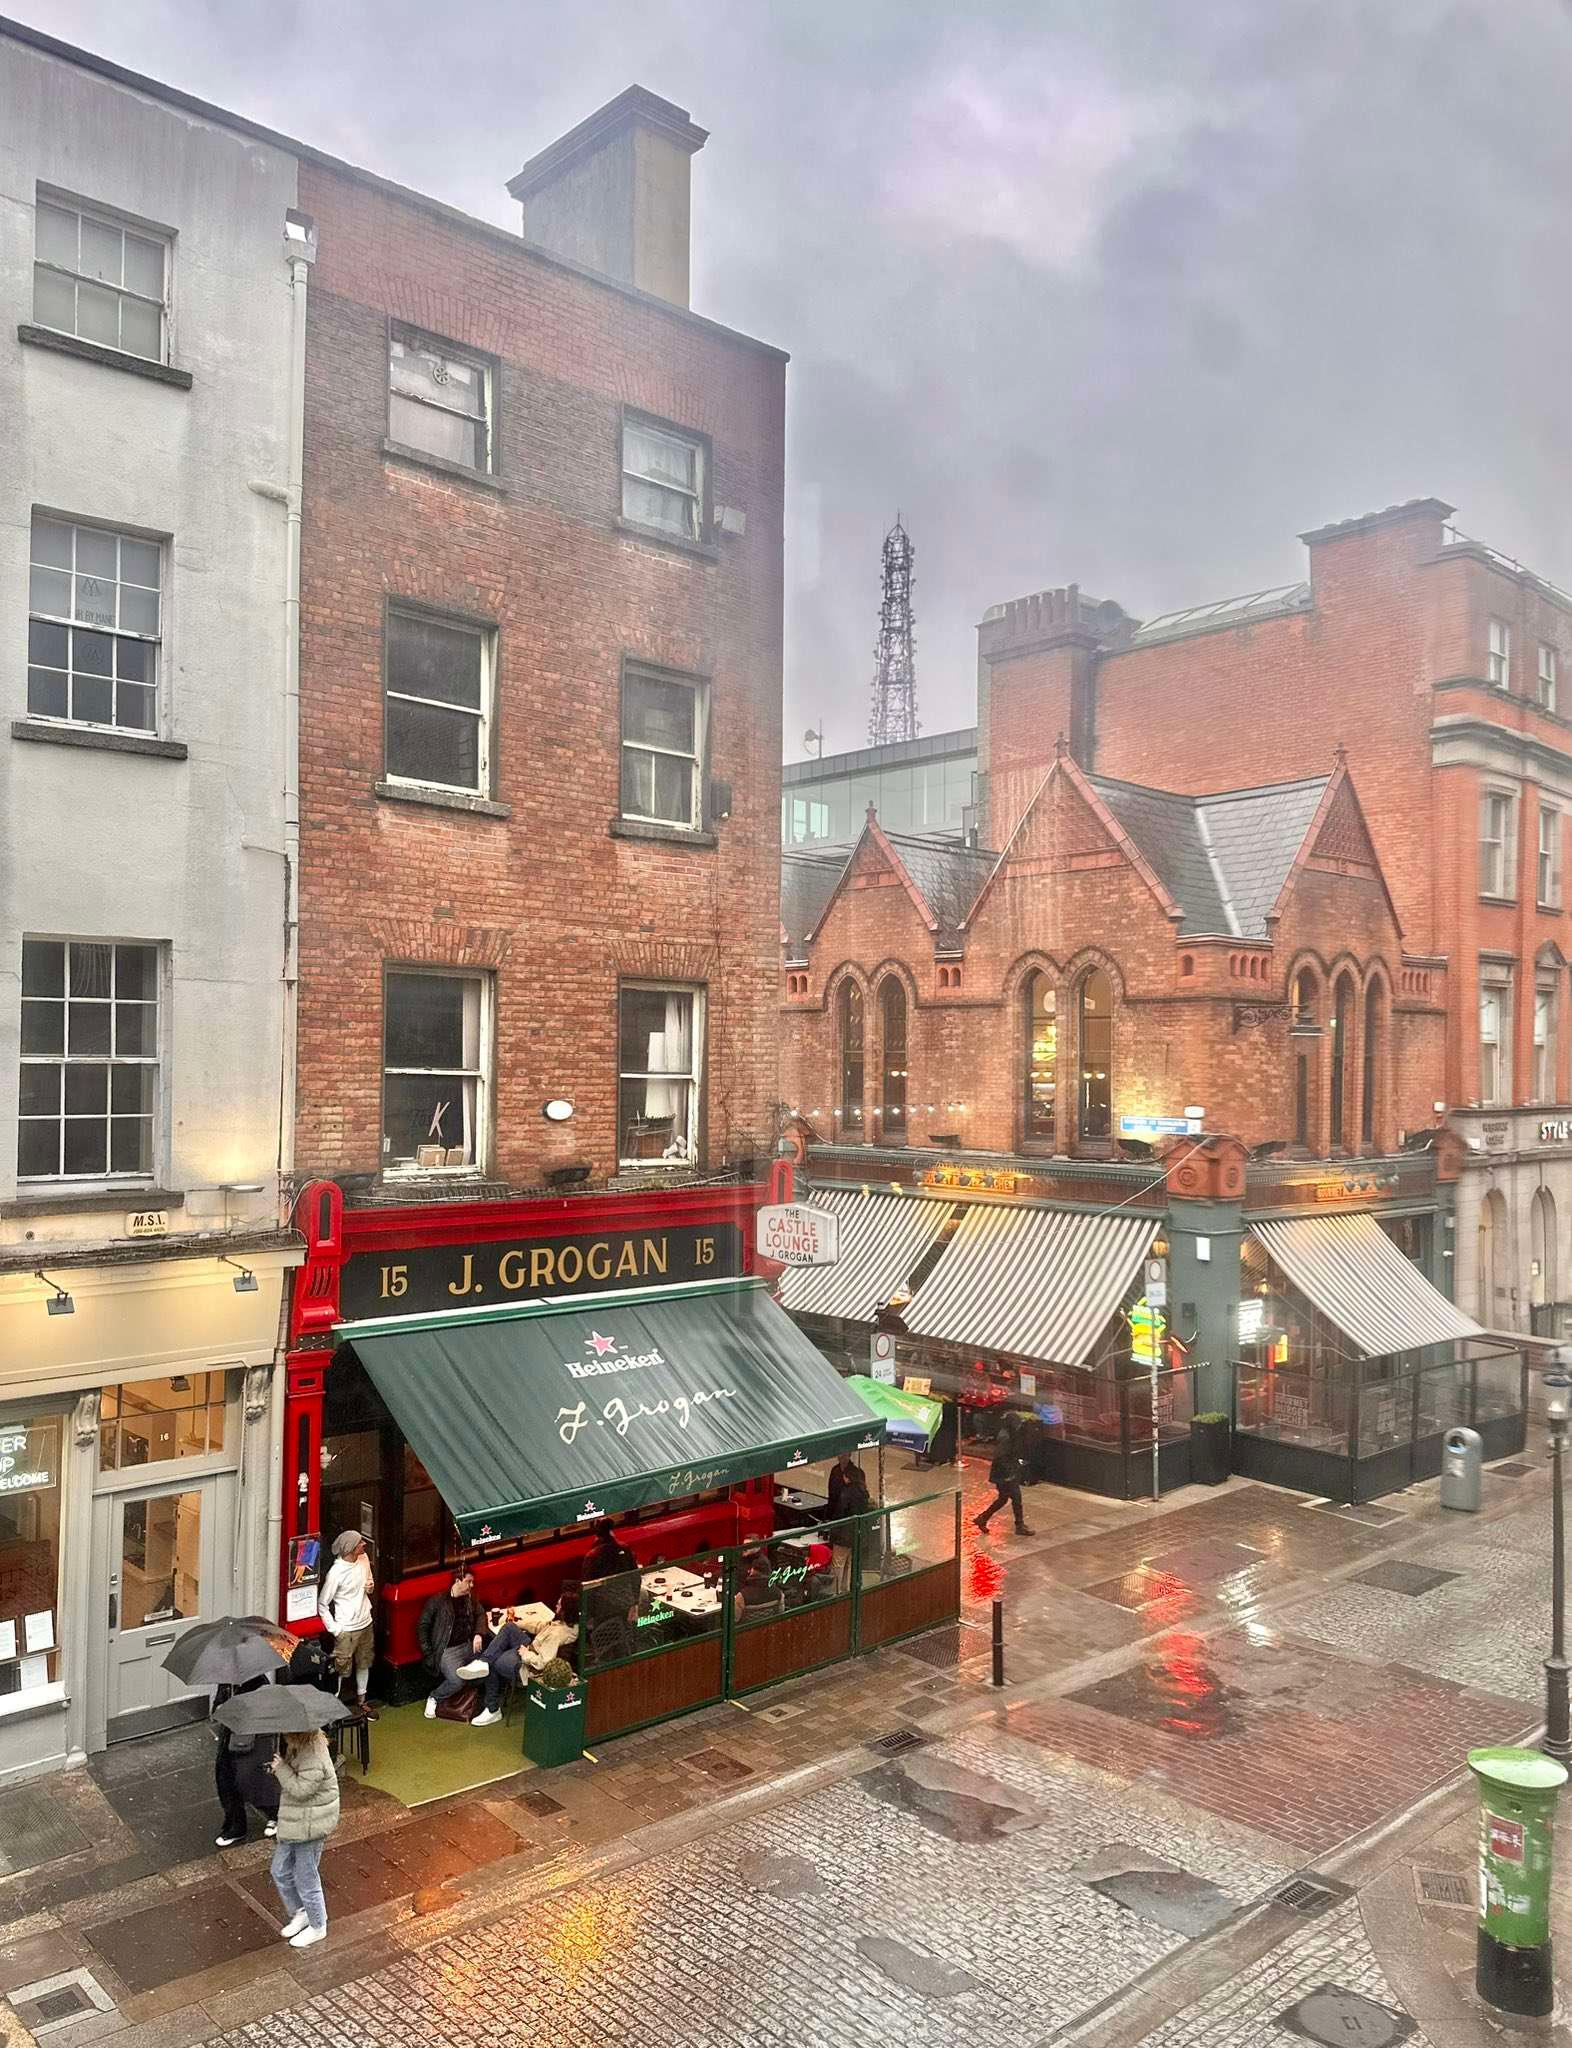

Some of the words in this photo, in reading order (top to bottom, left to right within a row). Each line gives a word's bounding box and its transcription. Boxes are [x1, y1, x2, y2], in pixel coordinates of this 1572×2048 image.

[133, 1214, 165, 1227] M.S.I.
[784, 1208, 800, 1219] THE
[768, 1217, 817, 1237] CASTLE
[766, 1233, 819, 1254] LOUNGE
[778, 1249, 814, 1263] GROGAN
[380, 1265, 408, 1298] 15
[448, 1254, 483, 1296] J.
[499, 1237, 668, 1290] GROGAN
[694, 1238, 715, 1265] 15
[564, 1348, 665, 1379] Heineken
[603, 1388, 737, 1437] Grogan
[0, 1456, 15, 1473] P
[637, 1611, 674, 1627] Heineken
